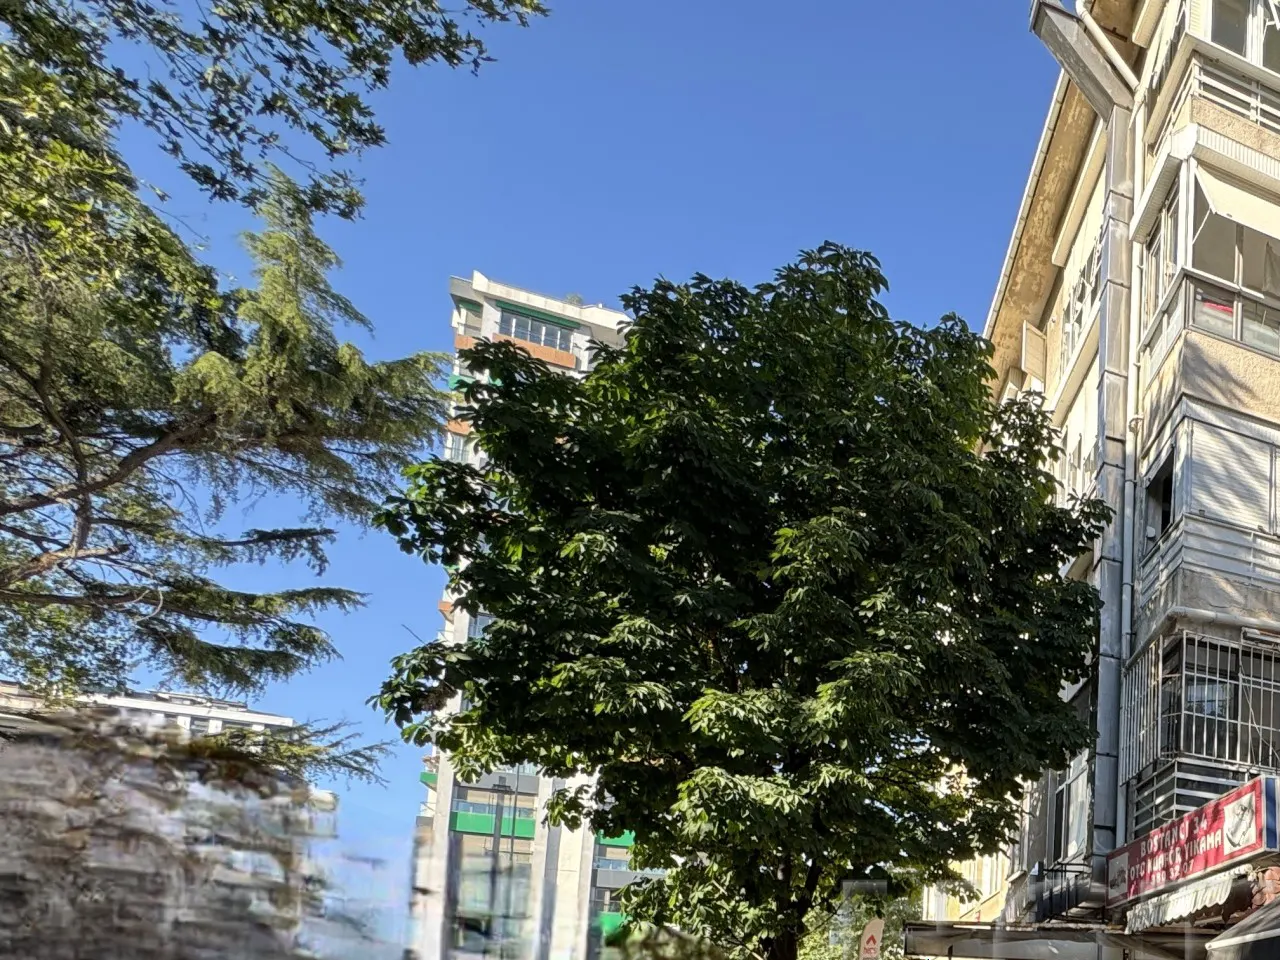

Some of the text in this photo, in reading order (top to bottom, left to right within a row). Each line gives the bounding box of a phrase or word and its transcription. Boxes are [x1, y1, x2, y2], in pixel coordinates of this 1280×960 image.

[1129, 860, 1145, 877] OTO
[1184, 830, 1222, 856] YIKAMA
[1140, 813, 1208, 855] BOSTANCI 34
[1169, 865, 1180, 878] 32
[1183, 859, 1194, 873] 07
